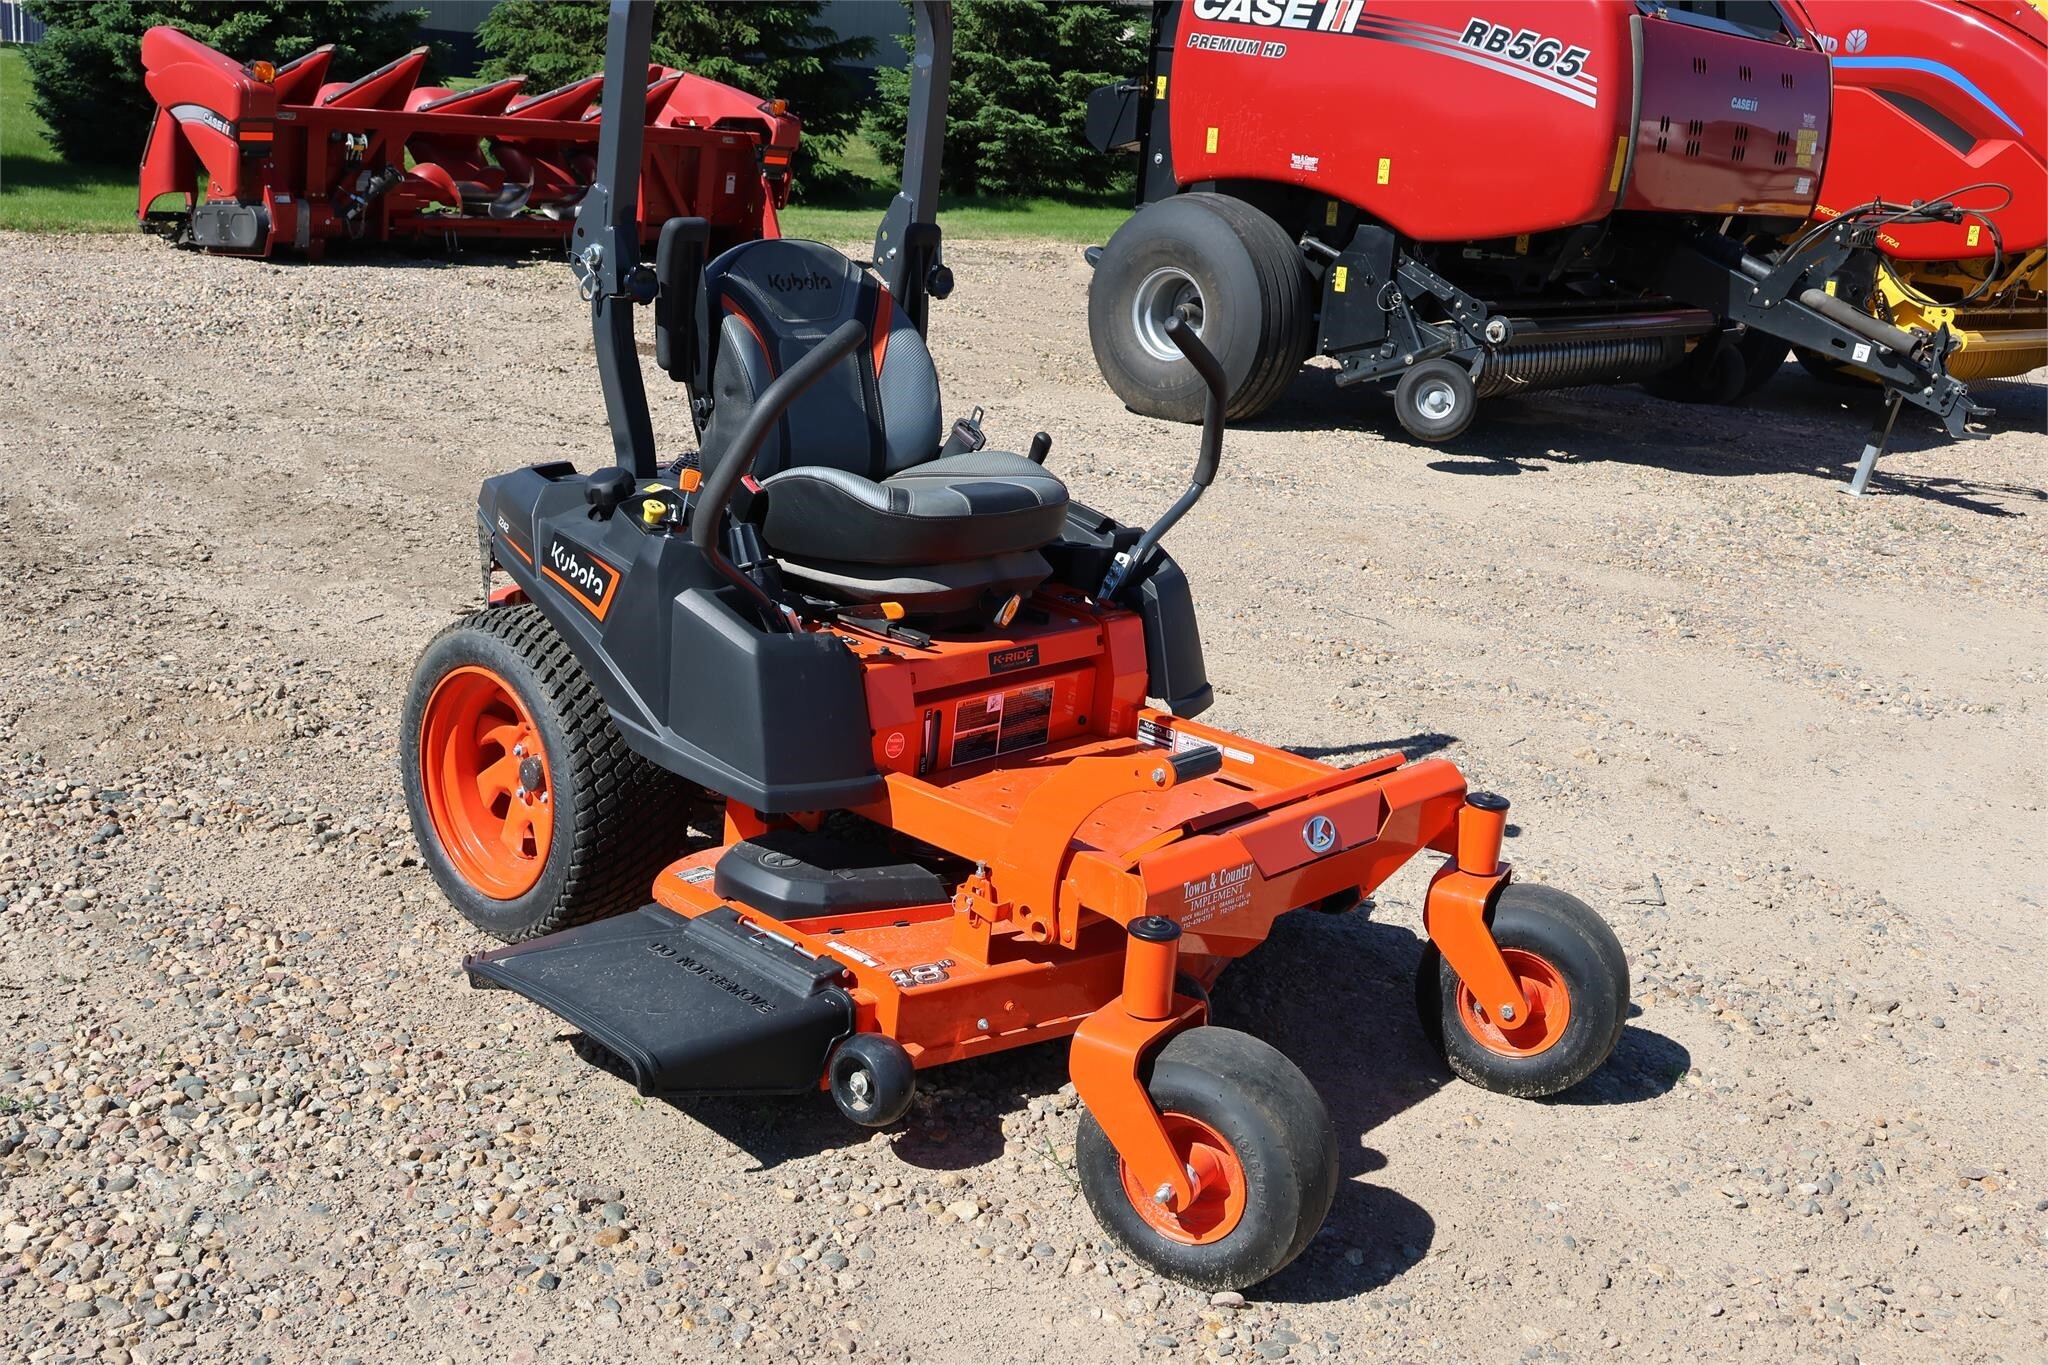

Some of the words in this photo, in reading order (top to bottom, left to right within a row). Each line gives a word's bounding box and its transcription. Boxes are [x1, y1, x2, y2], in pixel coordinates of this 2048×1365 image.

[1192, 0, 1316, 30] CASE
[1186, 33, 1262, 56] PREMIUM
[1260, 42, 1287, 59] HD
[1458, 16, 1592, 78] RB565
[768, 272, 832, 293] Kubota
[550, 541, 604, 597] Kubota
[1183, 881, 1207, 899] Town
[1209, 872, 1217, 890] &
[1220, 863, 1254, 885] Country
[1190, 883, 1245, 912] IMPLEMENT
[647, 943, 677, 957] DO
[674, 956, 713, 976] NOT
[707, 974, 777, 1014] REMOVE
